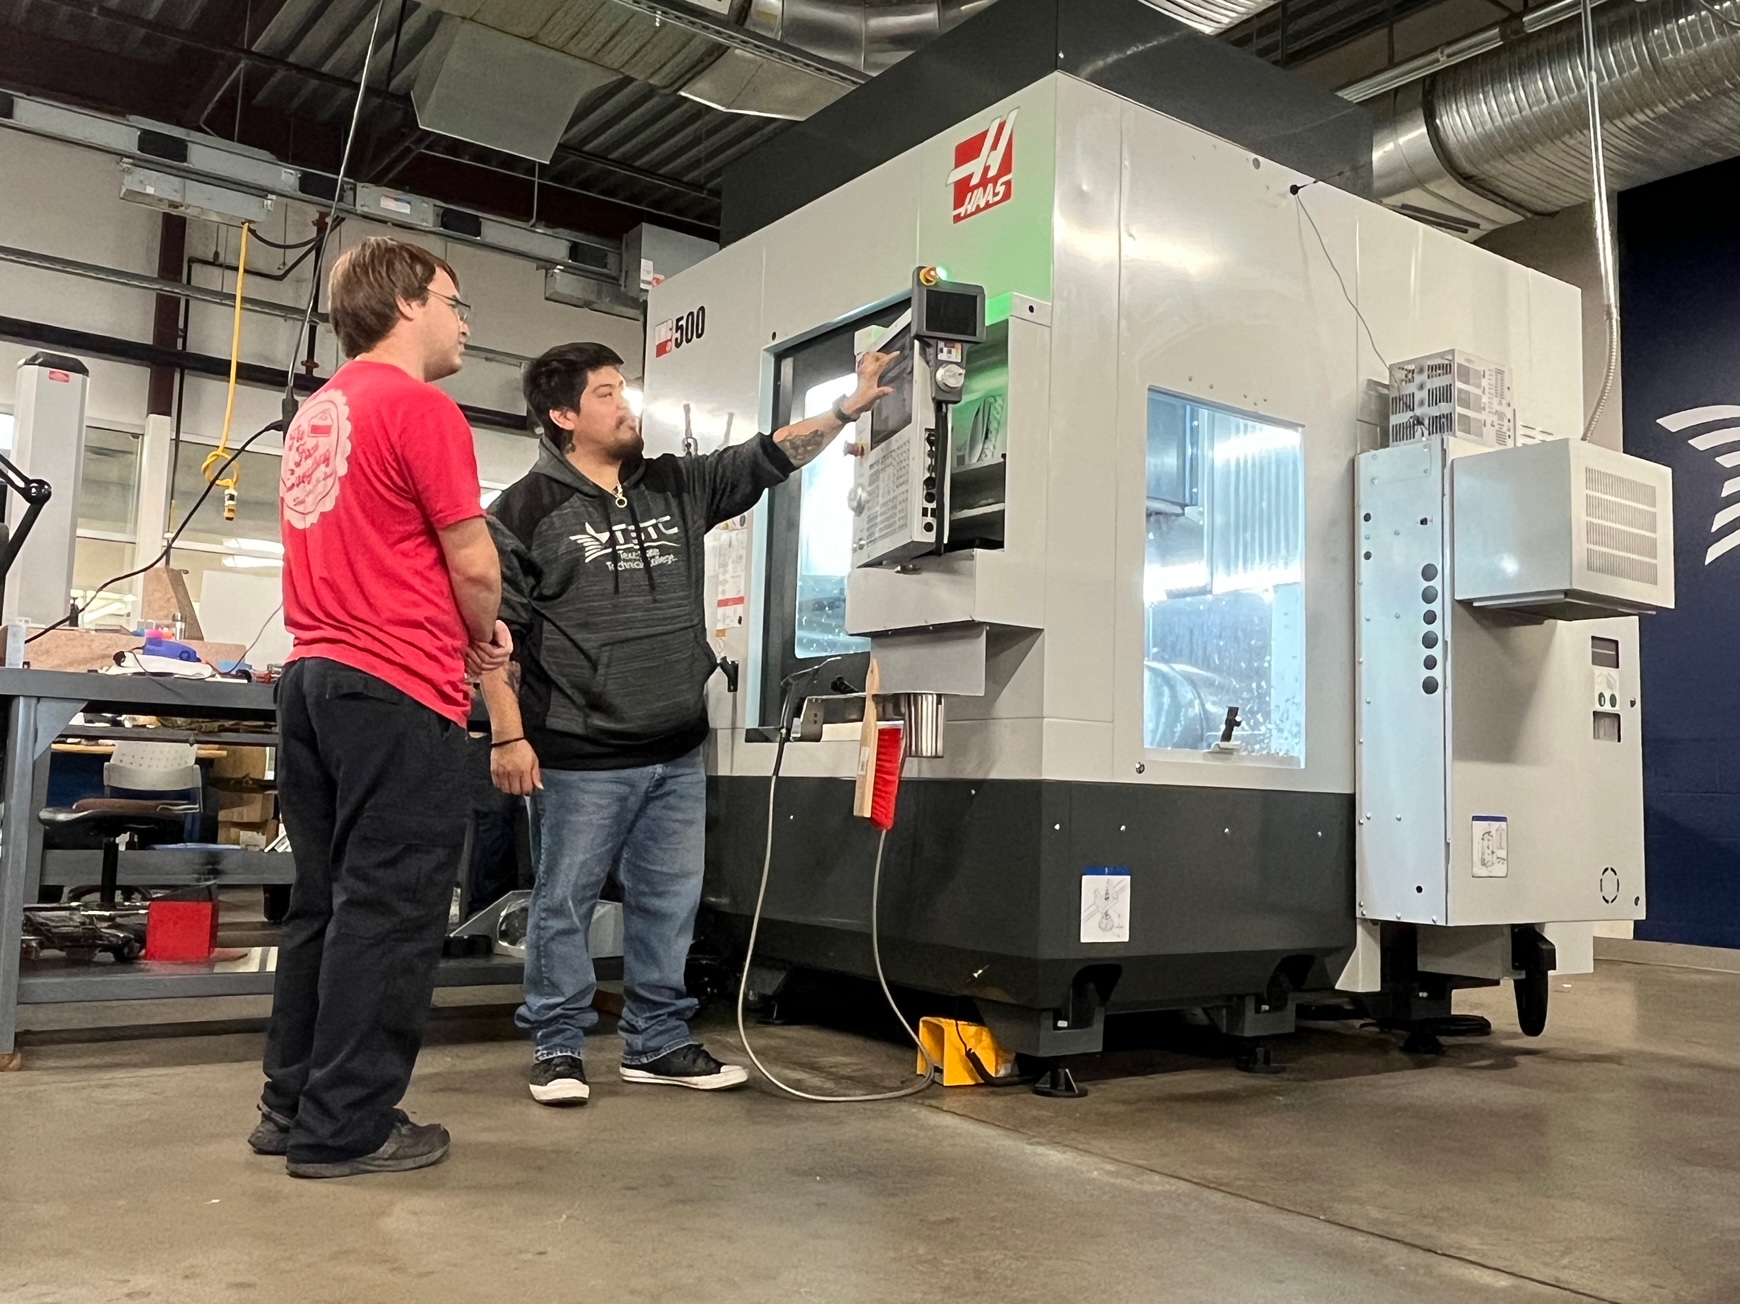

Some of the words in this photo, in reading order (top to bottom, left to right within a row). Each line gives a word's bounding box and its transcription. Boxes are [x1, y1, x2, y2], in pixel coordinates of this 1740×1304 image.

[952, 172, 1013, 217] HAAS
[675, 305, 706, 349] 500
[617, 550, 641, 560] Texa
[648, 553, 678, 568] ollege
